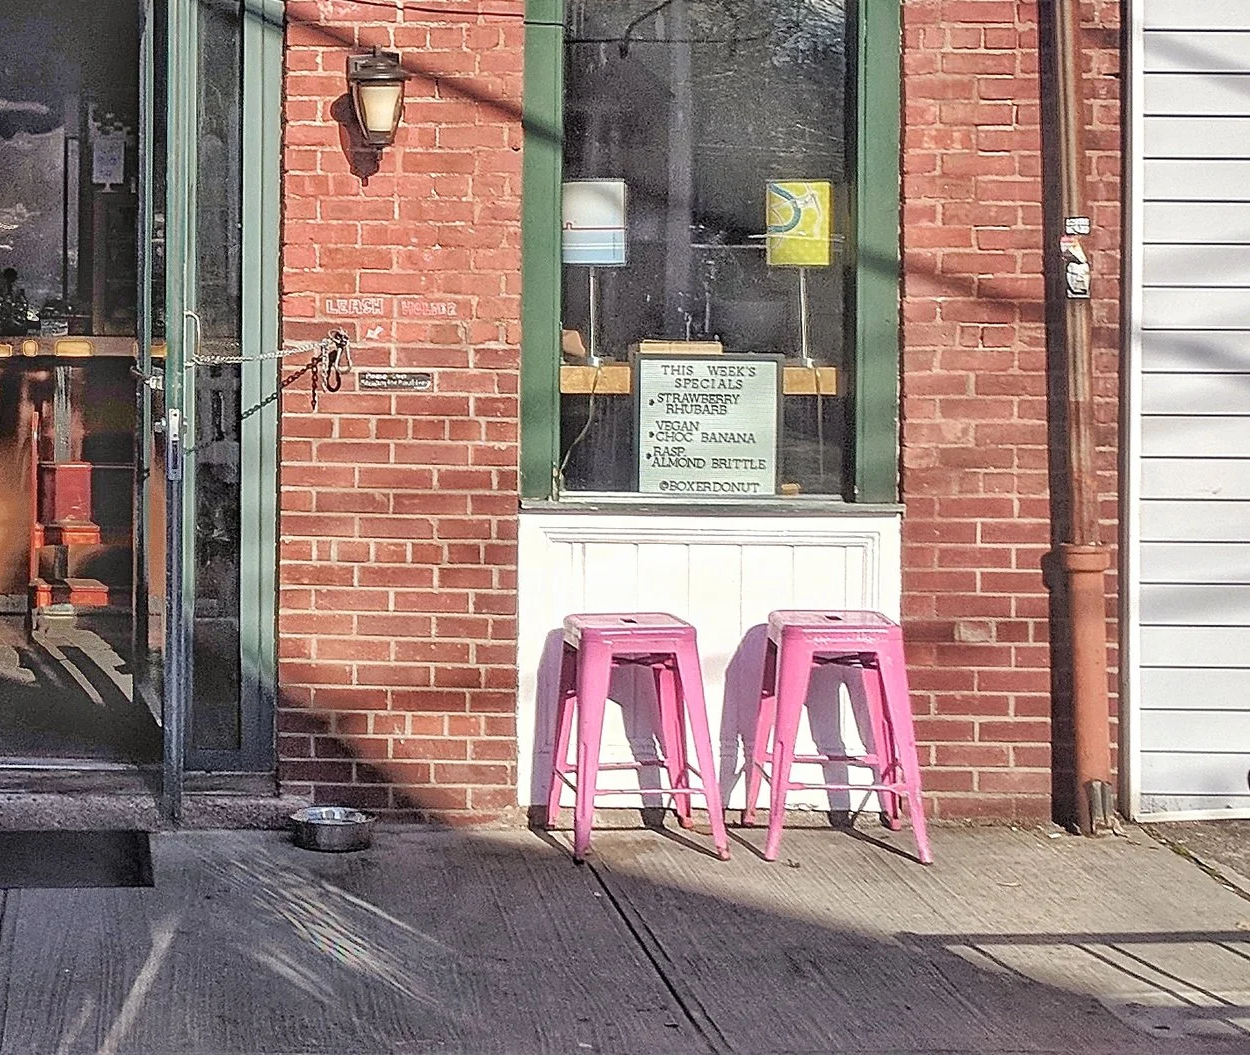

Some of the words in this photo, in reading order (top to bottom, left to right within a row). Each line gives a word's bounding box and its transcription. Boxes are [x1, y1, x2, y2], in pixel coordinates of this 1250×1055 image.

[325, 298, 384, 315] LEASH
[661, 365, 694, 376] THIS
[707, 365, 757, 377] WEEK'S
[674, 378, 744, 389] SPECIALS
[657, 393, 740, 404] STRAWBERRY
[666, 404, 728, 415] RHUBARB
[655, 420, 700, 431] VEGAN
[655, 431, 694, 442] CHOC
[701, 432, 757, 443] BANANA
[651, 457, 706, 468] ALMOND
[710, 458, 767, 469] BRITTLE
[659, 481, 761, 492] @BOXERDONUT
